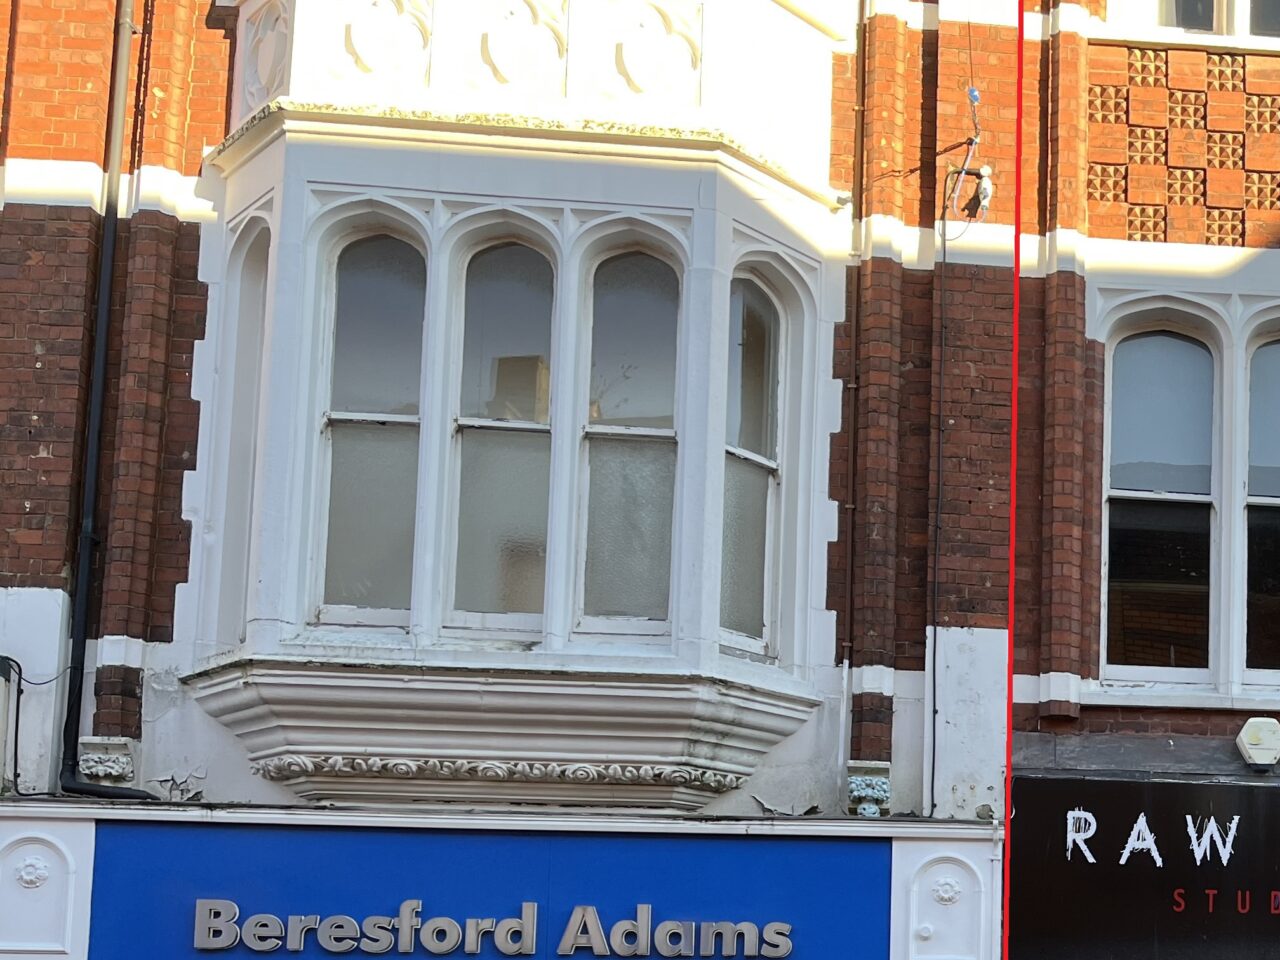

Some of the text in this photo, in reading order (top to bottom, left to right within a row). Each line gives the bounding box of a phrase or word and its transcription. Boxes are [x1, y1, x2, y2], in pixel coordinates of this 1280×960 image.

[1066, 806, 1241, 867] RAW
[193, 899, 793, 958] Beresford Adams
